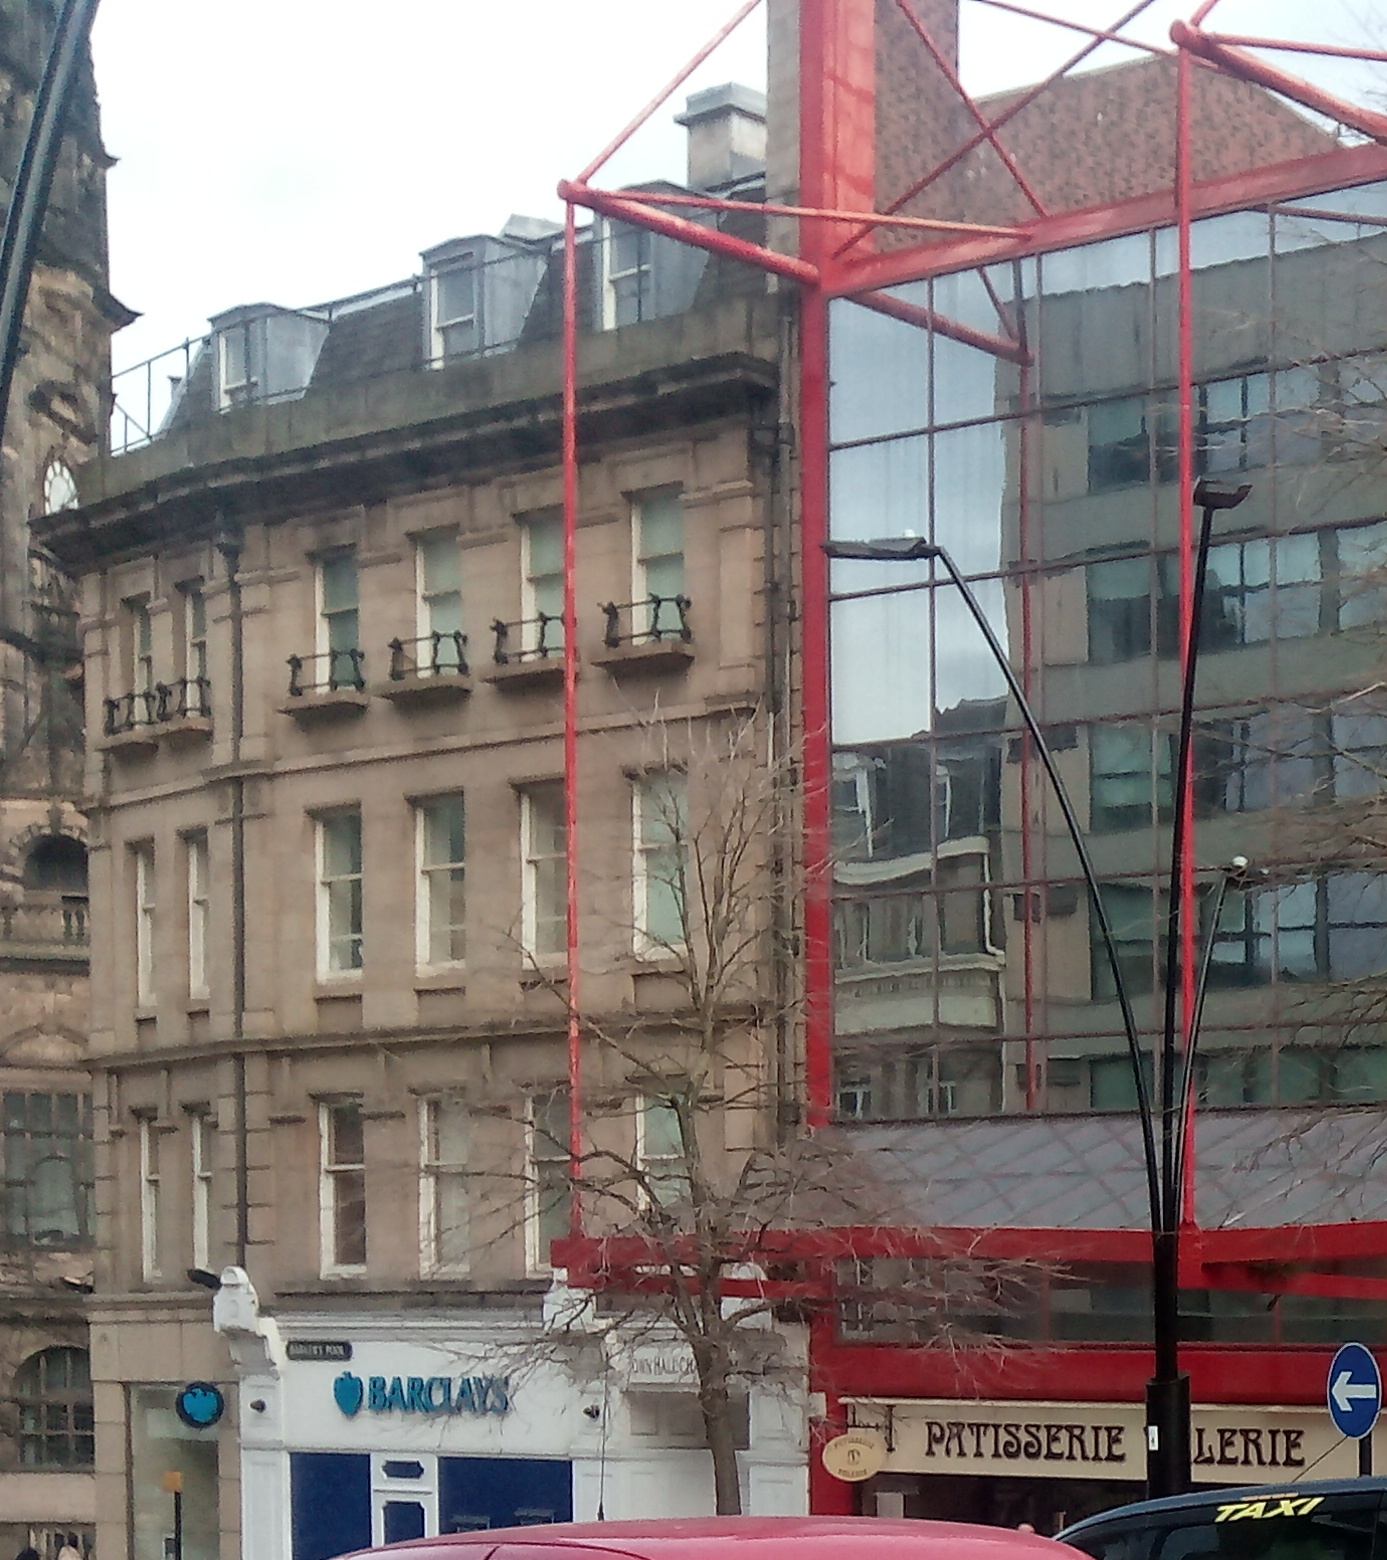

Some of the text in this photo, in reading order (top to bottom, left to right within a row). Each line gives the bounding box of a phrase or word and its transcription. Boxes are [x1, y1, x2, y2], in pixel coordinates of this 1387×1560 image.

[368, 1376, 509, 1416] BARCLAYS
[926, 1421, 1305, 1467] PATISSERIE LERIE
[1213, 1496, 1326, 1524] TAXI
